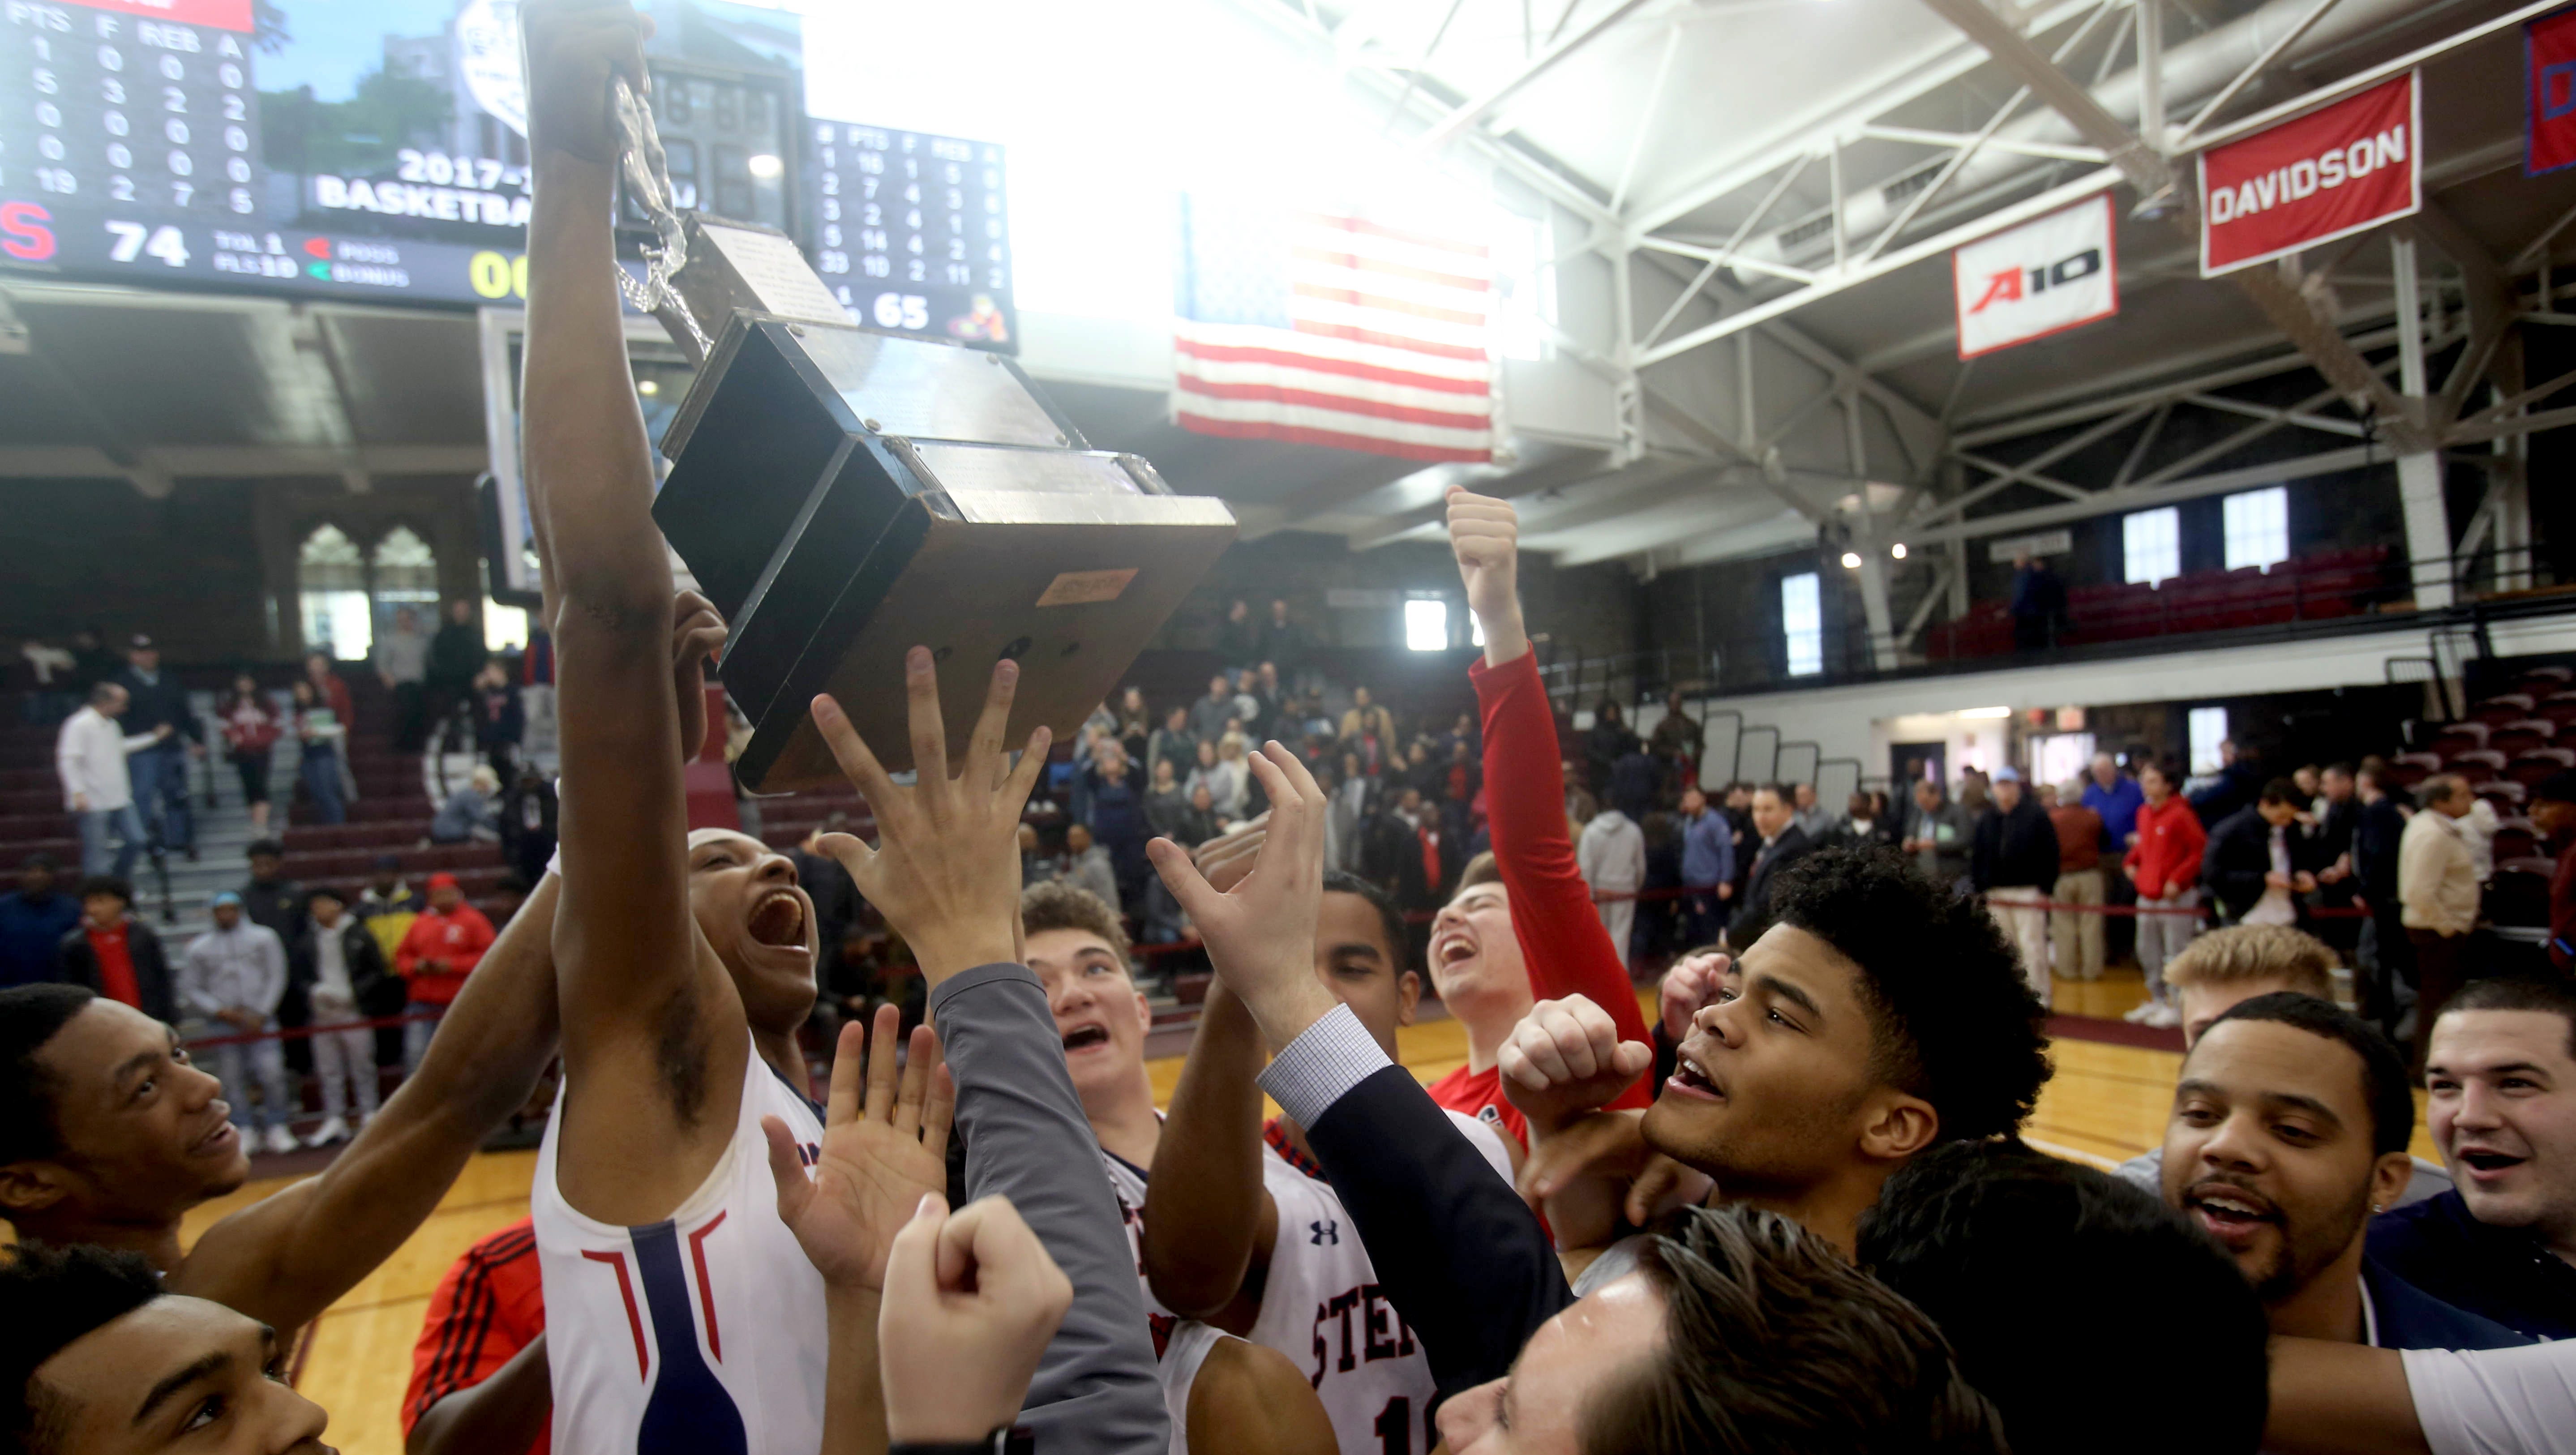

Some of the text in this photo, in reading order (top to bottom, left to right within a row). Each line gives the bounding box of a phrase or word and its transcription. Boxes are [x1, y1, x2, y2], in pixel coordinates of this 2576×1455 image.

[5, 1, 243, 60] PTS F REB A
[34, 35, 243, 89] 1 0 0 0
[101, 77, 126, 104] 3
[163, 86, 187, 113] 2
[223, 94, 246, 121] 2
[35, 101, 249, 152] 0 0 0 0
[39, 134, 251, 183] 0 0 0 0
[821, 146, 836, 168] 1
[904, 158, 918, 179] 1
[2210, 123, 2405, 226] DAVIDSON
[110, 175, 136, 201] 2
[171, 180, 194, 207] 7
[821, 171, 840, 195] 2
[863, 177, 879, 199] 7
[0, 201, 57, 260] S
[822, 197, 841, 221] 3
[864, 202, 882, 226] 2
[105, 220, 190, 268] 74
[265, 231, 286, 255] 1
[948, 237, 965, 260] 2
[331, 262, 410, 287] BONUS
[908, 258, 926, 282] 2
[873, 292, 929, 330] 65
[1375, 1396, 1439, 1455] 1
